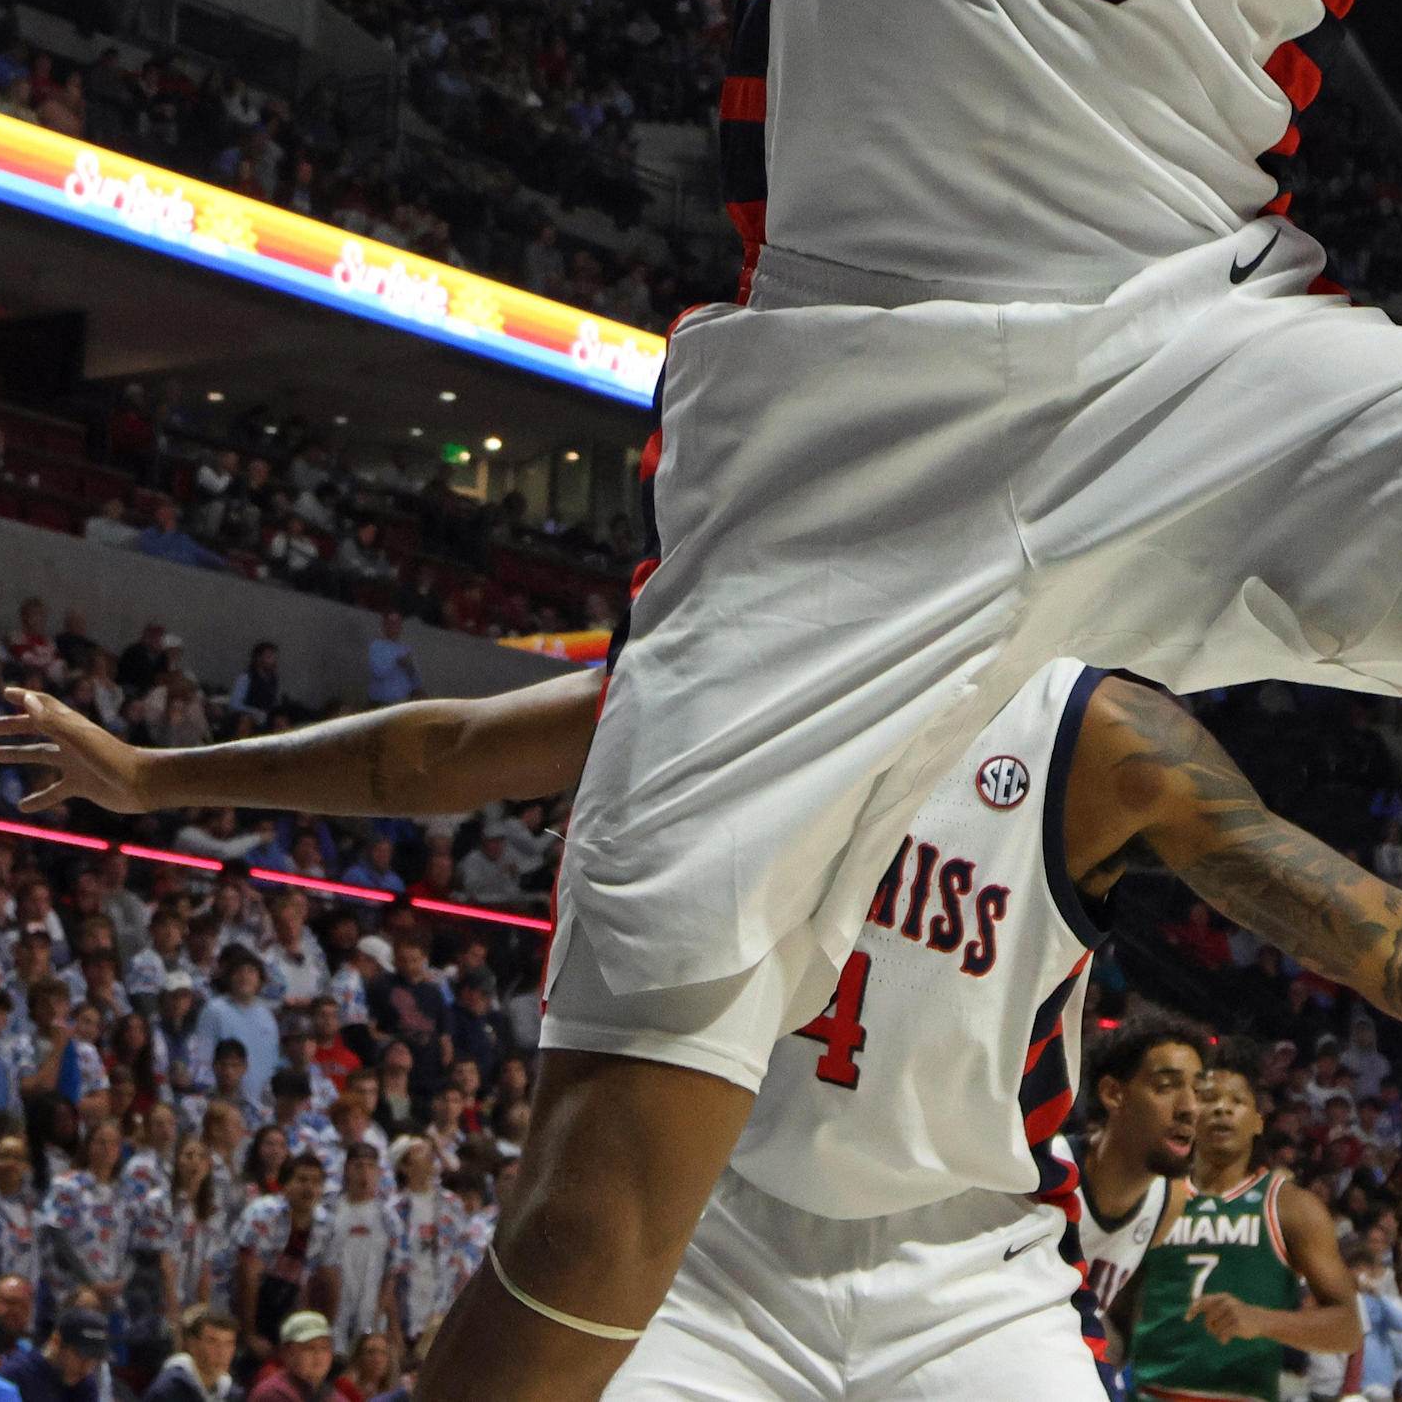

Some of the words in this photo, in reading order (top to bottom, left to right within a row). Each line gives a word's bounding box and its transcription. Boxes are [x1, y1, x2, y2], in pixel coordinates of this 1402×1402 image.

[979, 758, 1028, 804] SEC
[794, 951, 873, 1089] 4
[1187, 1254, 1220, 1300] 7
